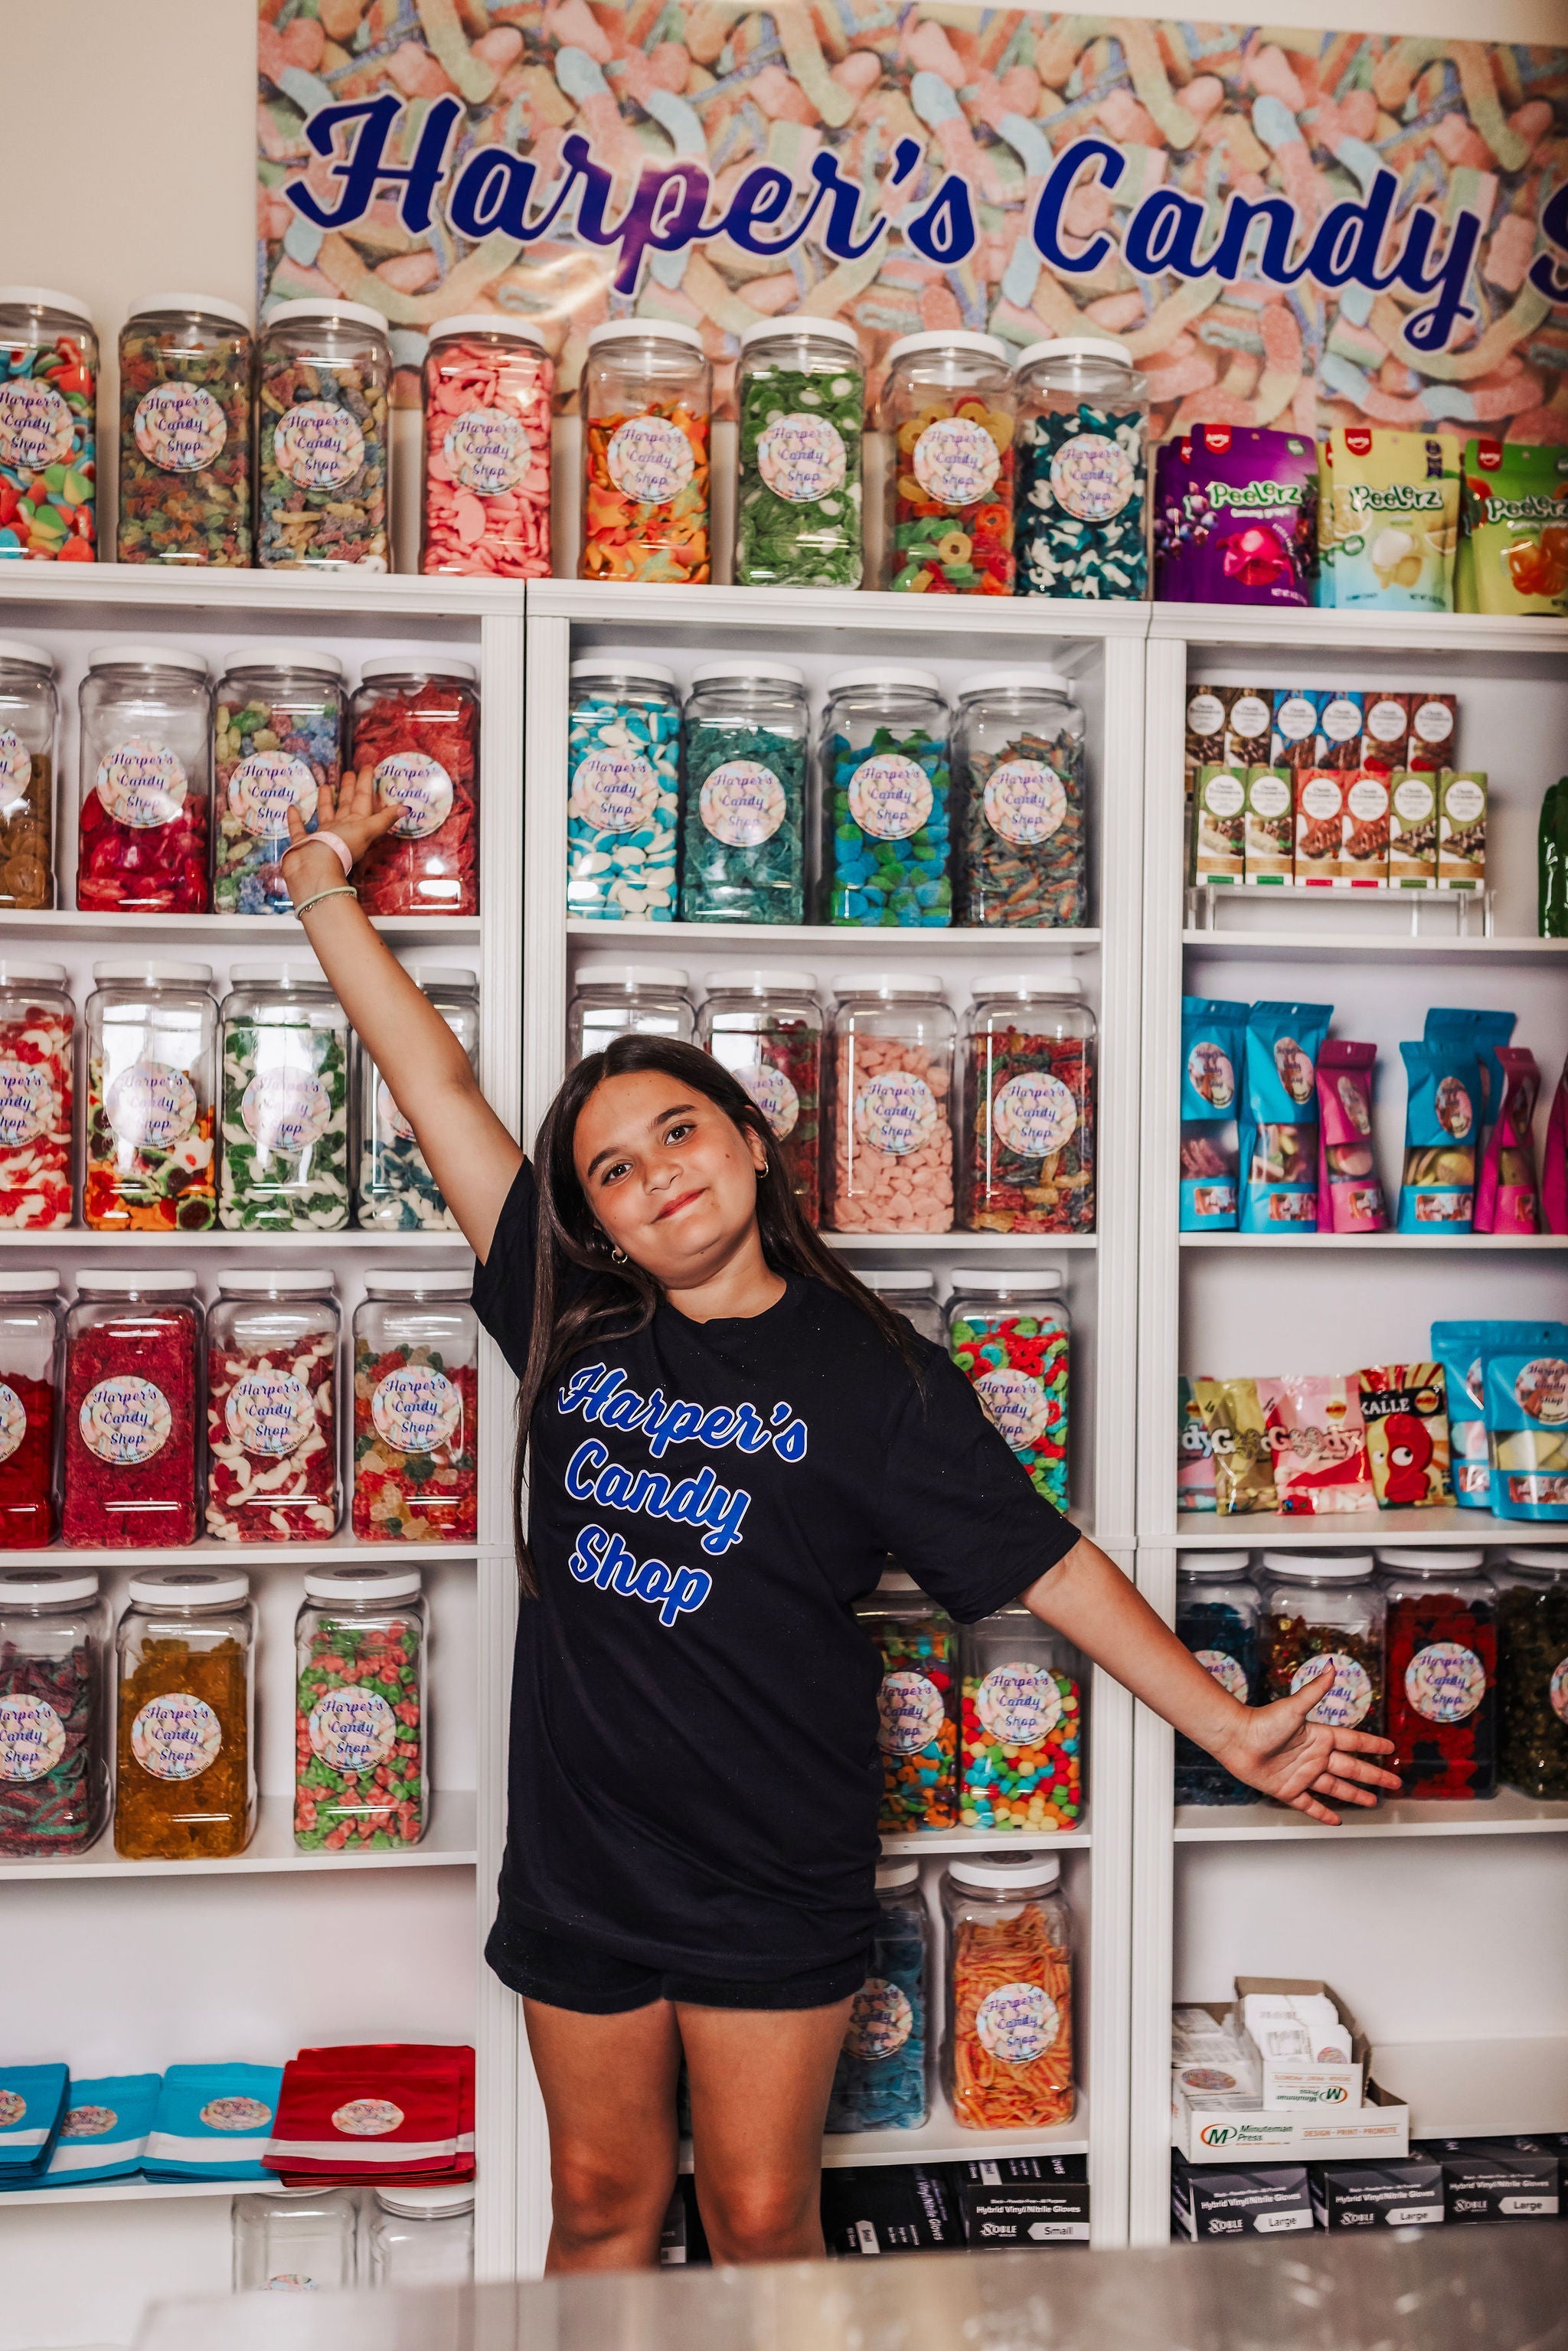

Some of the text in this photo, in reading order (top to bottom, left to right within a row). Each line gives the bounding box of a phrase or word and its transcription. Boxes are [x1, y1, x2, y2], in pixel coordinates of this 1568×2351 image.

[286, 93, 976, 296] Harper's
[1034, 139, 1481, 351] Candy
[147, 397, 209, 411] Harper's
[4, 415, 51, 433] Candy
[158, 419, 203, 433] Candy
[287, 416, 349, 430] Harper's
[459, 422, 518, 435] Harper's
[623, 429, 682, 444] Harper's
[772, 427, 832, 439] Harper's
[929, 431, 988, 444] Harper's
[11, 437, 47, 452] Shop
[168, 440, 201, 453] Shop
[296, 438, 341, 452] Candy
[466, 442, 508, 459] Candy
[629, 452, 672, 468] Candy
[780, 449, 824, 464] Candy
[936, 454, 978, 469] Candy
[1063, 449, 1120, 461] Harper's
[305, 459, 338, 472] Shop
[473, 465, 505, 477] Shop
[636, 472, 668, 485] Shop
[789, 471, 820, 482] Shop
[942, 475, 975, 486] Shop
[1072, 470, 1112, 485] Candy
[1080, 491, 1111, 502] Shop
[1209, 481, 1302, 509] Peelerz
[1351, 485, 1442, 511] Peelerz
[111, 755, 173, 768] Harper's
[589, 760, 647, 774] Harper's
[243, 765, 304, 777] Harper's
[381, 765, 436, 778] Harper'
[861, 768, 920, 780] Harper's
[121, 776, 164, 790] Candy
[714, 776, 773, 788] Harper's
[996, 772, 1053, 785] Harper's
[252, 788, 295, 802] Candy
[389, 788, 430, 802] Candy
[595, 783, 637, 798] Candy
[871, 789, 912, 805] Candy
[722, 797, 764, 811] Candy
[1005, 795, 1046, 808] Candy
[406, 808, 425, 821] op
[601, 803, 633, 816] Shop
[877, 809, 908, 821] Shop
[1011, 815, 1043, 827] Shop
[0, 1076, 41, 1088] rper's
[867, 1084, 925, 1097] Harper's
[1008, 1086, 1065, 1099] Harper's
[0, 1097, 31, 1110] andy
[876, 1106, 916, 1120] Candy
[1015, 1107, 1056, 1122] Candy
[0, 1116, 25, 1128] hop
[145, 1118, 169, 1131] hop
[281, 1124, 303, 1135] hop
[881, 1125, 912, 1138] Shop
[1021, 1127, 1052, 1140] Shop
[239, 1382, 299, 1396] Harper's
[386, 1378, 446, 1392] Harper's
[978, 1381, 1037, 1393] Harper's
[93, 1390, 156, 1404] Harper's
[250, 1404, 292, 1418] Candy
[395, 1399, 437, 1414] Candy
[558, 1362, 808, 1463] Harper's
[104, 1412, 148, 1426] Candy
[256, 1425, 289, 1437] Shop
[402, 1422, 434, 1434] Shop
[111, 1432, 145, 1445] Shop
[564, 1437, 751, 1556] Candy
[567, 1523, 712, 1627] Shop
[1419, 1655, 1475, 1667] Harper's
[991, 1676, 1048, 1687] Harper's
[1426, 1676, 1466, 1689] Candy
[1328, 1687, 1351, 1701] ndy
[1432, 1694, 1463, 1705] Shop
[322, 1700, 382, 1713] Harper's
[999, 1696, 1040, 1709] Candy
[0, 1709, 51, 1722] arper's
[146, 1707, 208, 1720] Harper's
[884, 1706, 923, 1719] Candy
[1317, 1707, 1348, 1717] Shop
[331, 1722, 374, 1735] Candy
[1005, 1716, 1037, 1728] Shop
[155, 1729, 198, 1742] Candy
[888, 1726, 920, 1738] Shop
[338, 1742, 370, 1754] Shop
[5, 1751, 39, 1763] Shop
[160, 1749, 194, 1762] Shop
[987, 1993, 1043, 2012] Harper's
[998, 2015, 1038, 2030] Candy
[1007, 2034, 1037, 2047] Shop
[1237, 2134, 1263, 2142] Press
[976, 2206, 1004, 2215] Hybrid
[1513, 2201, 1543, 2211] Large
[1268, 2217, 1297, 2228] Large
[1400, 2212, 1428, 2221] Large
[928, 2219, 944, 2241] Gloves
[1044, 2226, 1073, 2235] Small
